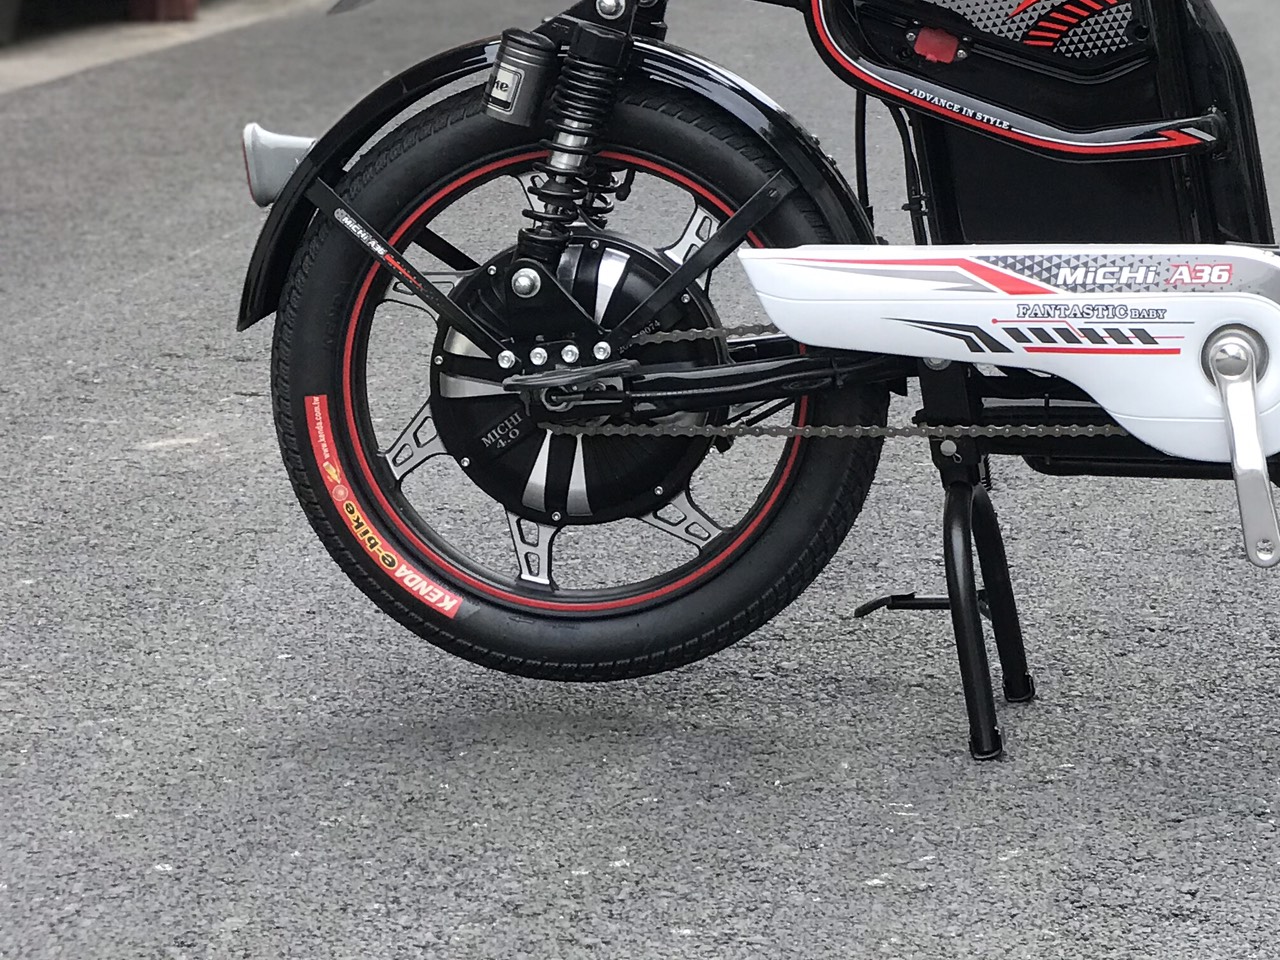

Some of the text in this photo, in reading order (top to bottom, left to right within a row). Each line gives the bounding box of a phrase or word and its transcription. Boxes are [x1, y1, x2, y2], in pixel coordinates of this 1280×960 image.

[910, 88, 1010, 130] ADVANCE IN STYLE
[368, 240, 387, 256] A36
[1164, 263, 1233, 285] A36
[1017, 303, 1167, 320] FANTASTIC BABY
[481, 412, 522, 447] MICHI
[343, 501, 458, 611] KENDA e-bike
